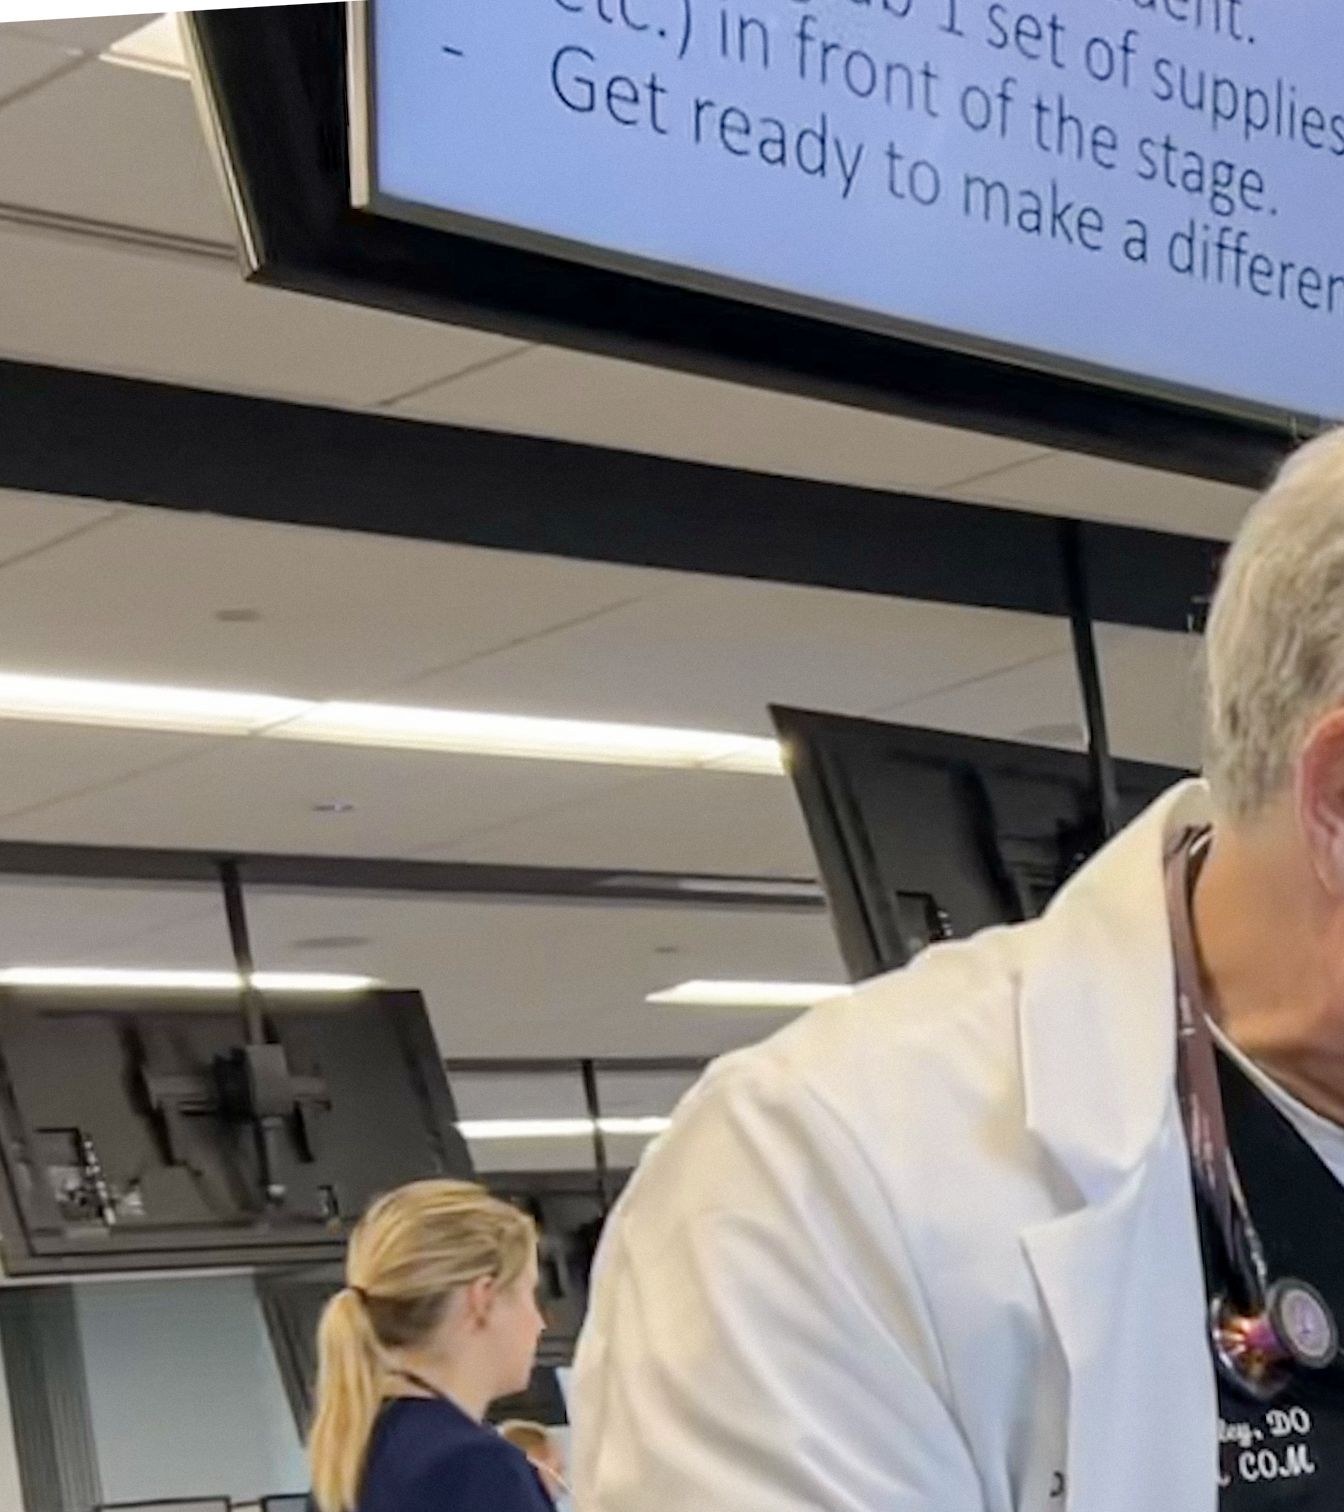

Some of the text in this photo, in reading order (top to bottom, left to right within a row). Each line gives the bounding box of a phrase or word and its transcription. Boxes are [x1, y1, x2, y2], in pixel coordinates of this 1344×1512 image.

[720, 8, 768, 70] in
[795, 14, 939, 119] front
[961, 76, 1018, 139] of
[1034, 98, 1119, 170] the
[1139, 135, 1279, 219] stage.
[986, 5, 1067, 70] set
[1085, 29, 1139, 88] of
[550, 45, 669, 135] Get
[693, 95, 864, 200] ready
[885, 141, 941, 206] to
[962, 169, 1105, 254] make
[1124, 215, 1149, 265] a
[1265, 1405, 1311, 1437] DO
